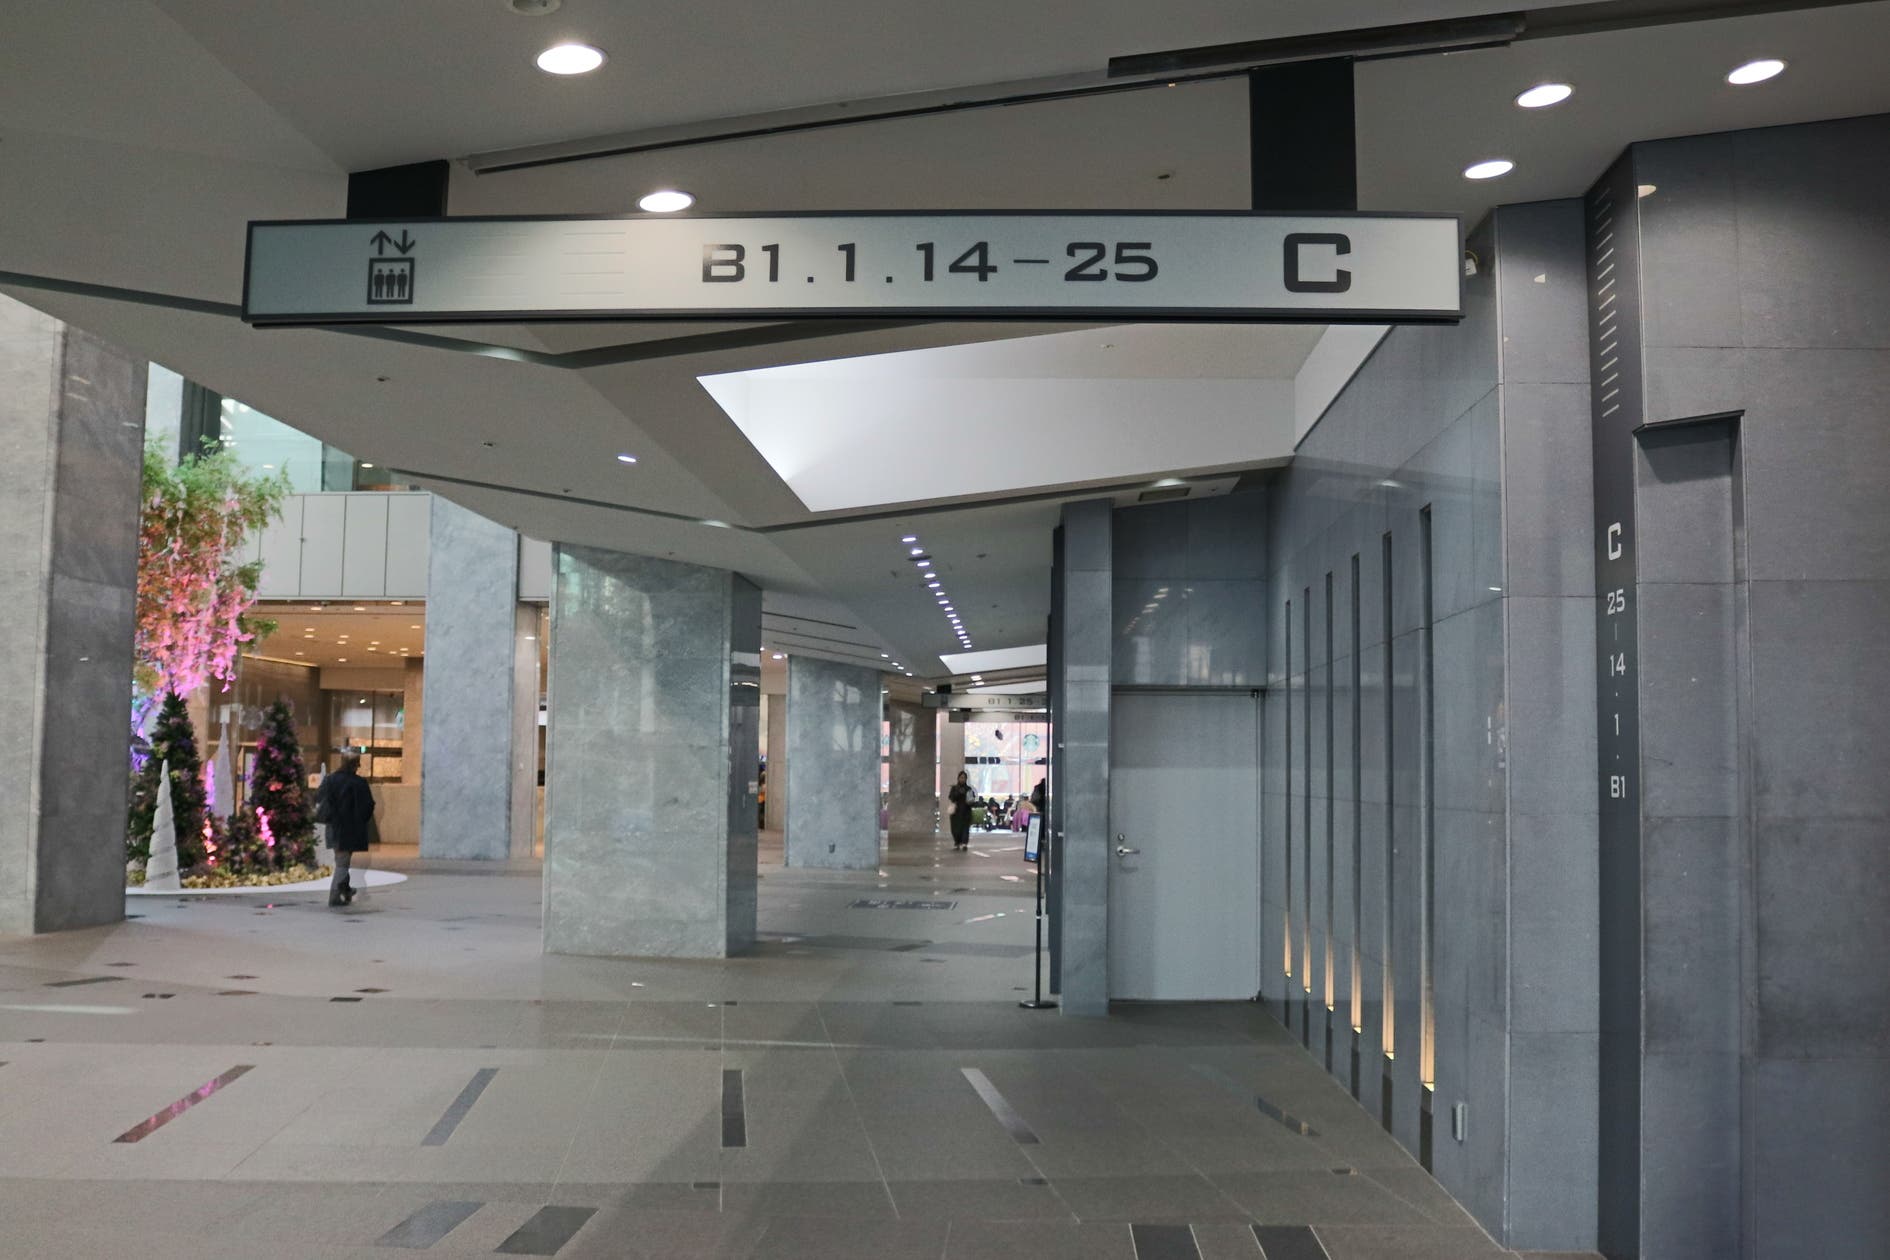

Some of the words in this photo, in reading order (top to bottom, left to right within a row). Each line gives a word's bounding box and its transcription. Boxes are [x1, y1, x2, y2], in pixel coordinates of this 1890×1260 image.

[1284, 233, 1351, 293] C
[1608, 522, 1621, 560] C
[1607, 589, 1625, 614] 25
[1610, 652, 1626, 677] 14
[1610, 775, 1626, 799] B1
